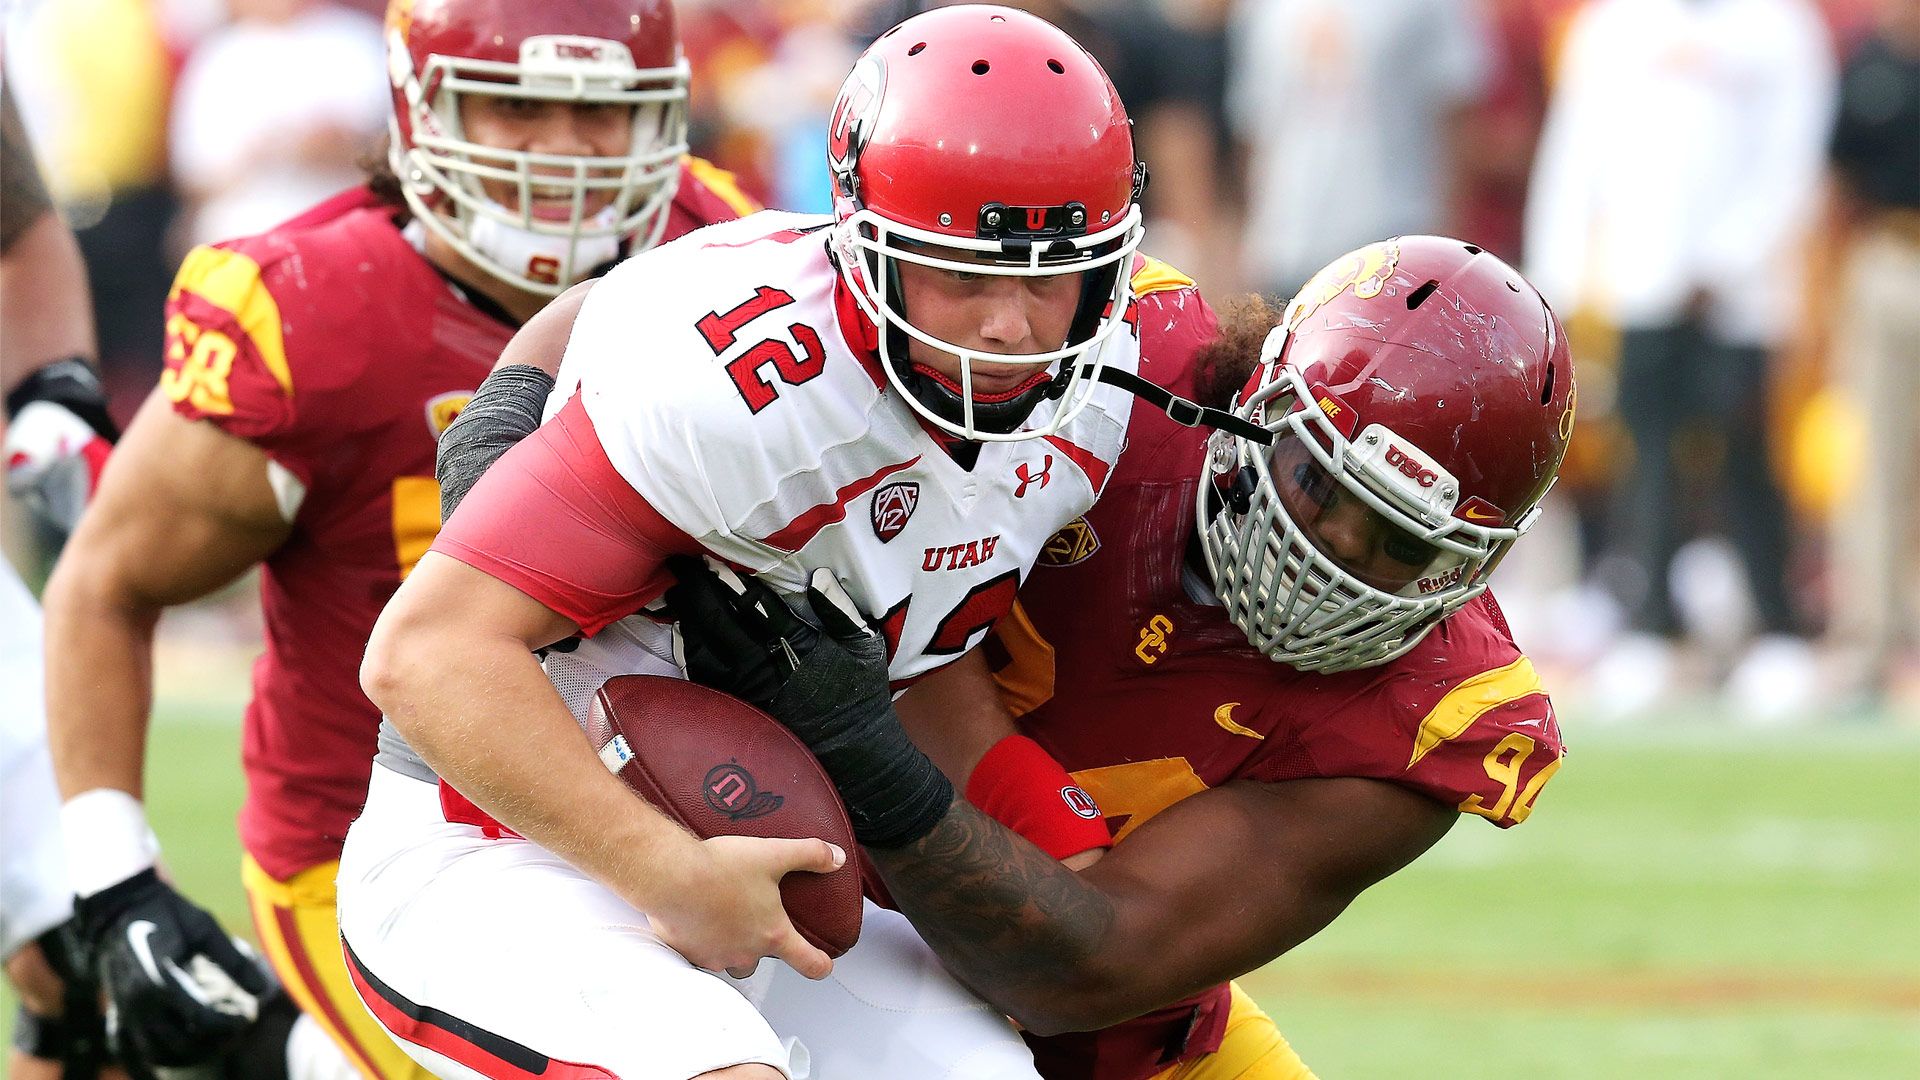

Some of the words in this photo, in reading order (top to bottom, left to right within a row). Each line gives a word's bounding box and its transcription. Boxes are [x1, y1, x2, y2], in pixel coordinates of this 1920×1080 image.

[1026, 208, 1048, 231] U
[694, 285, 827, 416] 12
[1317, 396, 1342, 419] NIKE
[1384, 443, 1438, 488] USC
[874, 485, 918, 523] PAC
[879, 508, 904, 532] 12
[921, 534, 1001, 572] UTAH
